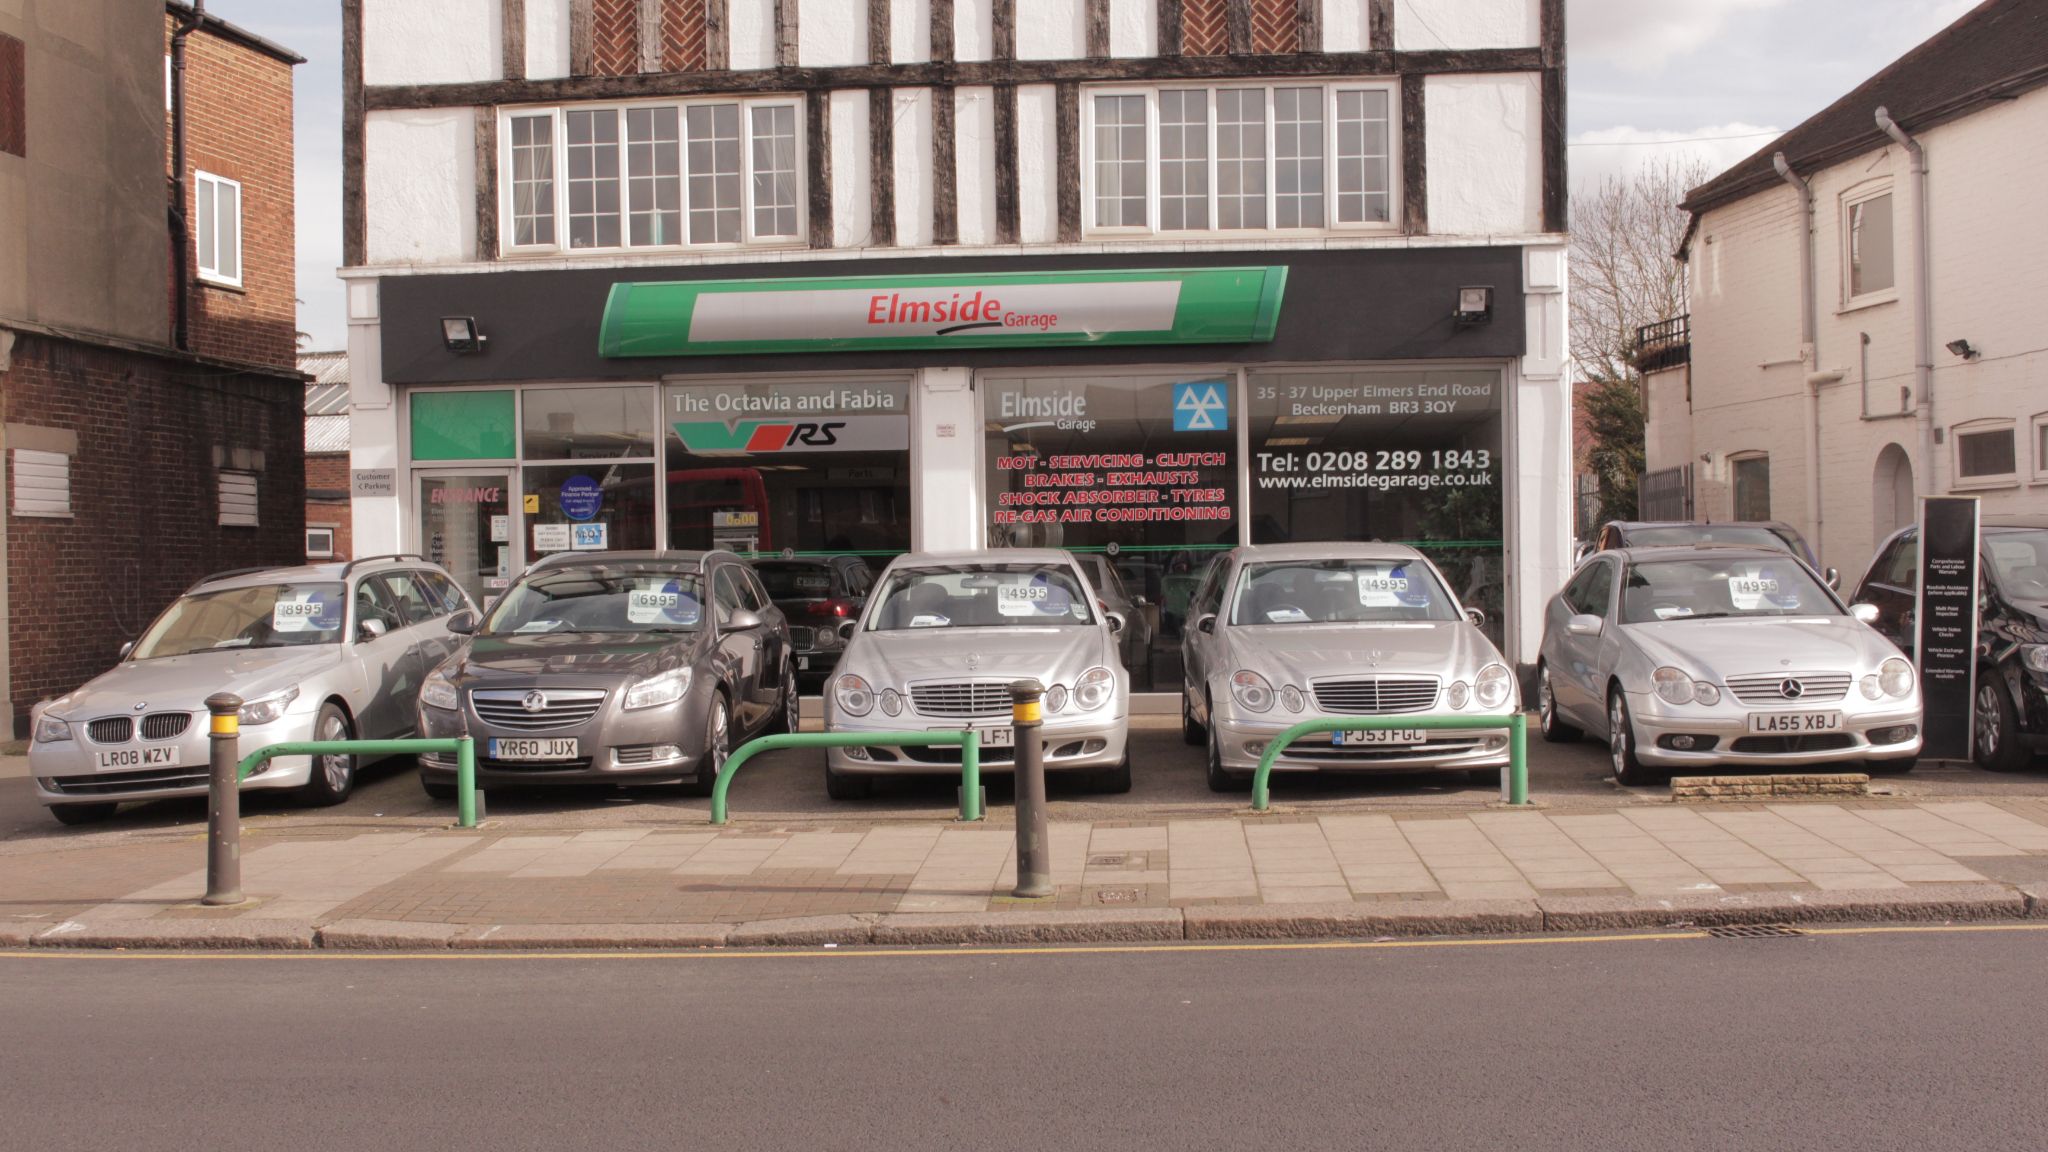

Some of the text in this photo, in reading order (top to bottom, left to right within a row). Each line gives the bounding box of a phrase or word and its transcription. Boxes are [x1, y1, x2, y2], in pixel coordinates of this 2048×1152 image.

[868, 291, 1001, 324] Elmside
[1004, 312, 1057, 330] Garage
[672, 389, 894, 412] The Octavia and Fabia
[1257, 387, 1276, 399] 35
[1289, 386, 1306, 399] 37
[1312, 386, 1358, 401] Upper
[1363, 385, 1414, 398] Elmers
[1418, 384, 1448, 397] End
[1452, 384, 1491, 396] Road
[1001, 390, 1086, 417] Elmside
[1292, 400, 1457, 415] Beckenham BR3 3QY
[1056, 418, 1096, 432] Garage
[997, 456, 1037, 470] MOT
[1049, 454, 1144, 469] SERVICING
[1156, 452, 1226, 467] CLUTCH
[1257, 449, 1491, 472] Tel: 0208 289 1843
[364, 482, 391, 490] Parking
[1024, 473, 1094, 487] BRAKES
[1107, 471, 1199, 486] EXHAUSTS
[1258, 471, 1492, 490] www.elmsidegarage.co.uk
[431, 487, 500, 503] ENTRANCE
[999, 492, 1060, 506] SHOCK
[1062, 490, 1159, 505] ABSORBER
[1171, 488, 1225, 502] TYRES
[994, 506, 1231, 524] RE-GAS AIR CONDITIONING
[1371, 579, 1407, 590] 4995
[640, 594, 676, 606] 6995
[1010, 588, 1047, 599] 4995
[286, 604, 322, 615] 8995
[1756, 714, 1836, 731] LA55 XBJ
[498, 740, 575, 756] YR60 JUX
[101, 747, 172, 767] LR08 WZV
